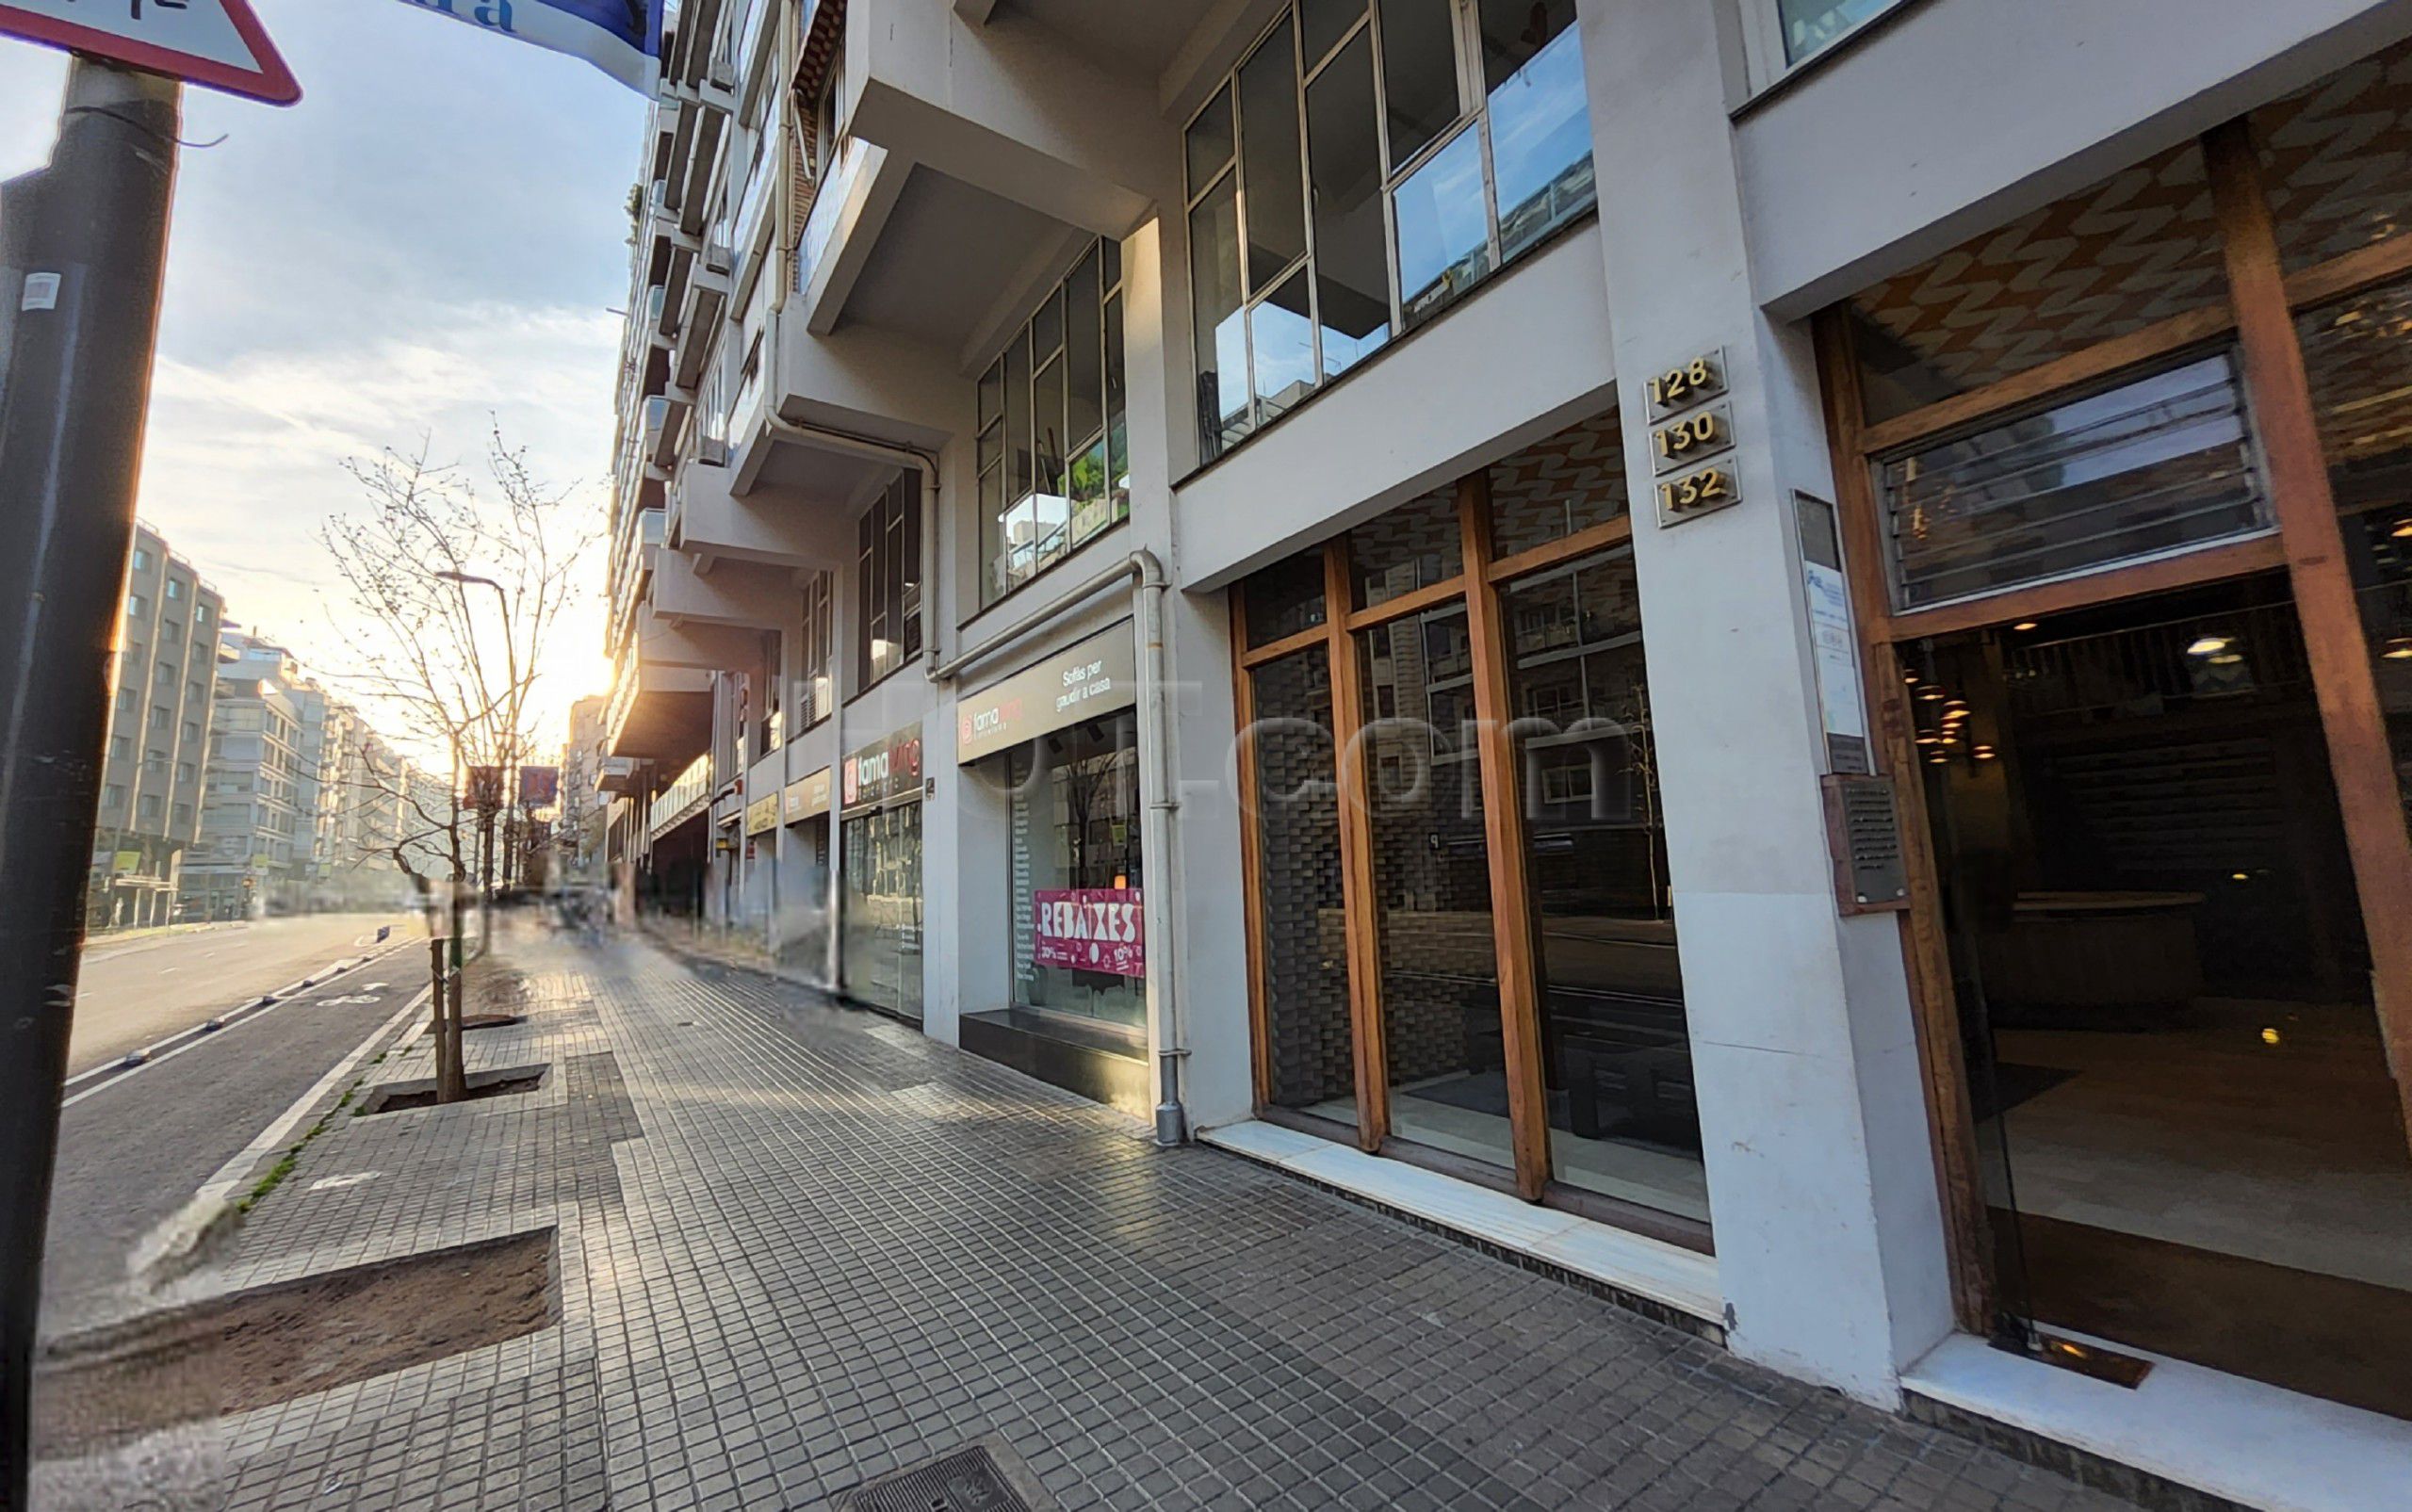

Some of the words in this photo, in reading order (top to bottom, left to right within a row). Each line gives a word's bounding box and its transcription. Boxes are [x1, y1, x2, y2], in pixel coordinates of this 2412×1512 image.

[1652, 356, 1708, 405] 128
[1655, 411, 1716, 459] 130
[1661, 467, 1727, 512] 132
[1083, 687, 1088, 699] a
[1089, 677, 1111, 696] casa
[1087, 660, 1101, 680] per
[1041, 902, 1135, 943] REBAIXES
